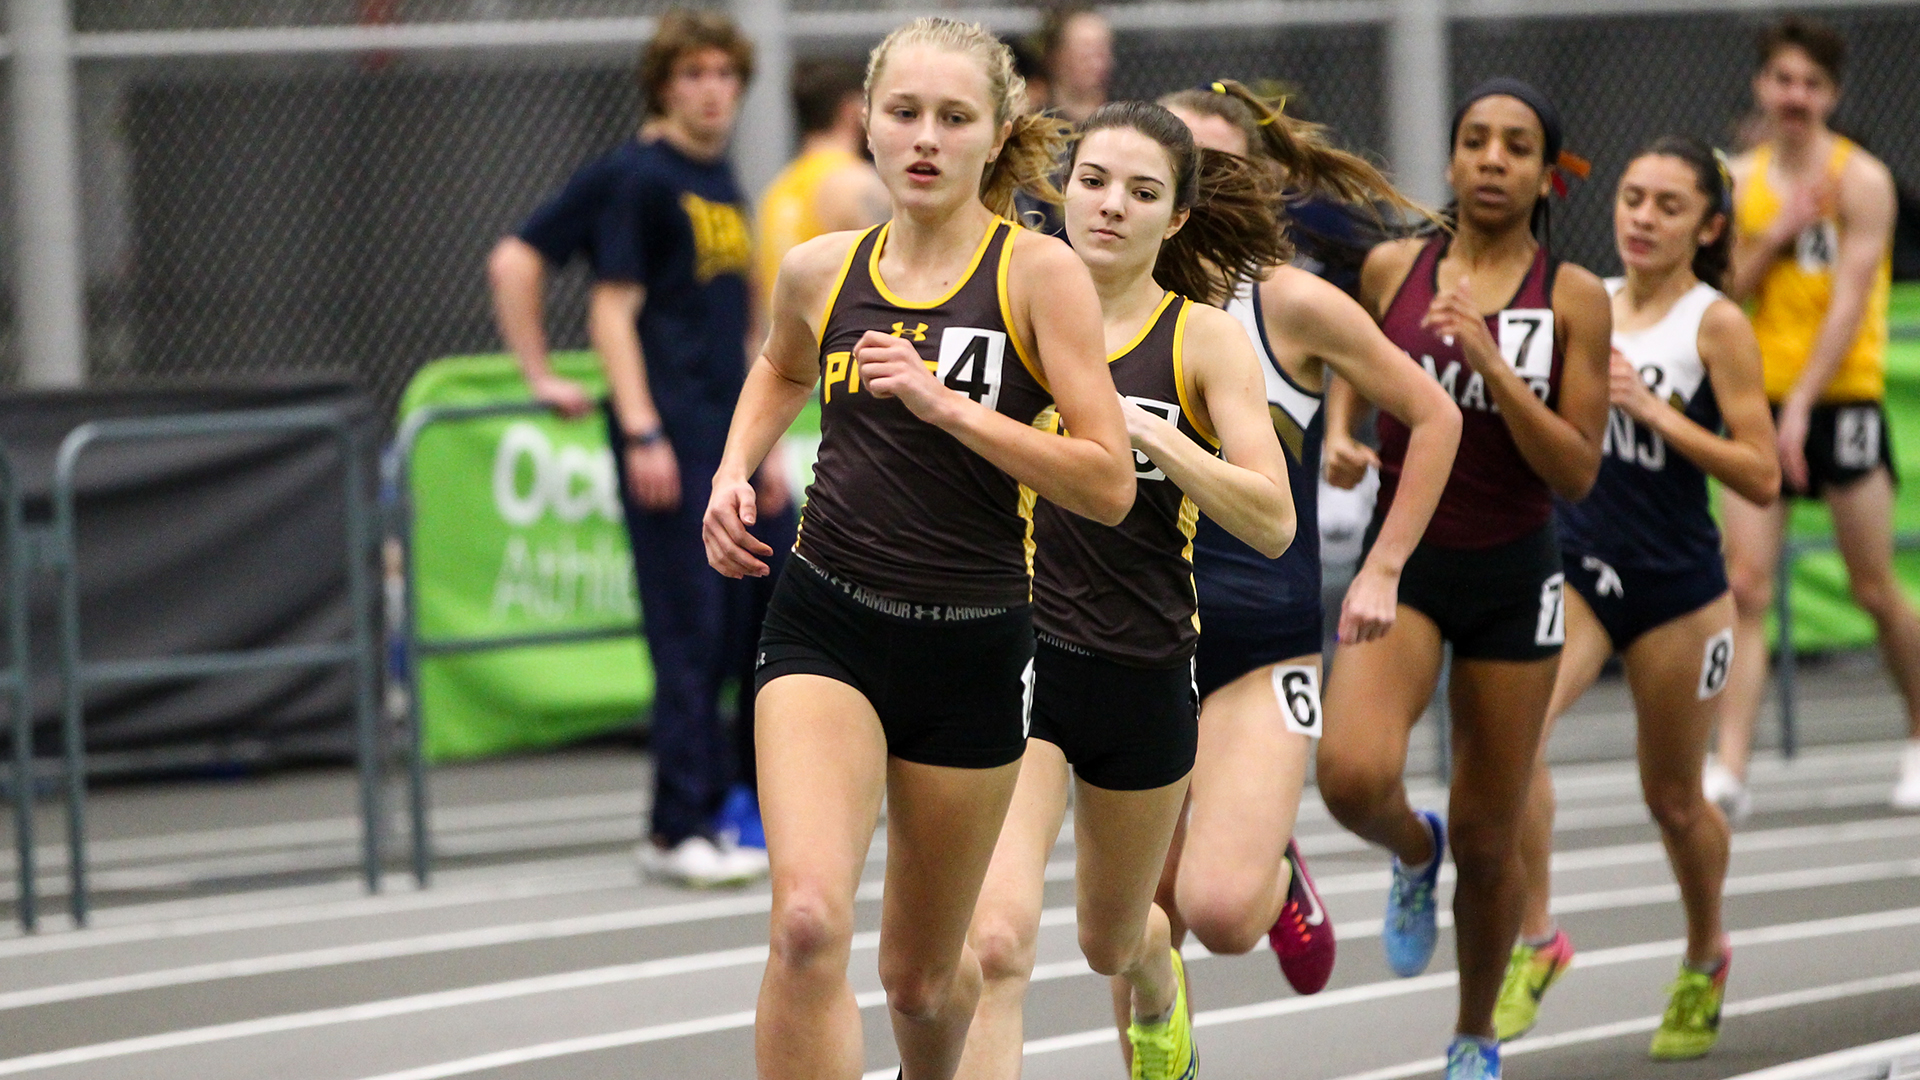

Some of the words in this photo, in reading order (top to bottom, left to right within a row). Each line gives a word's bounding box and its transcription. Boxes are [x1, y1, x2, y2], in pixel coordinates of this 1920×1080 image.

[944, 335, 991, 403] 4
[1507, 318, 1543, 369] 7
[852, 587, 911, 619] ARMOUR
[1705, 638, 1730, 690] 8
[1281, 671, 1316, 728] 6
